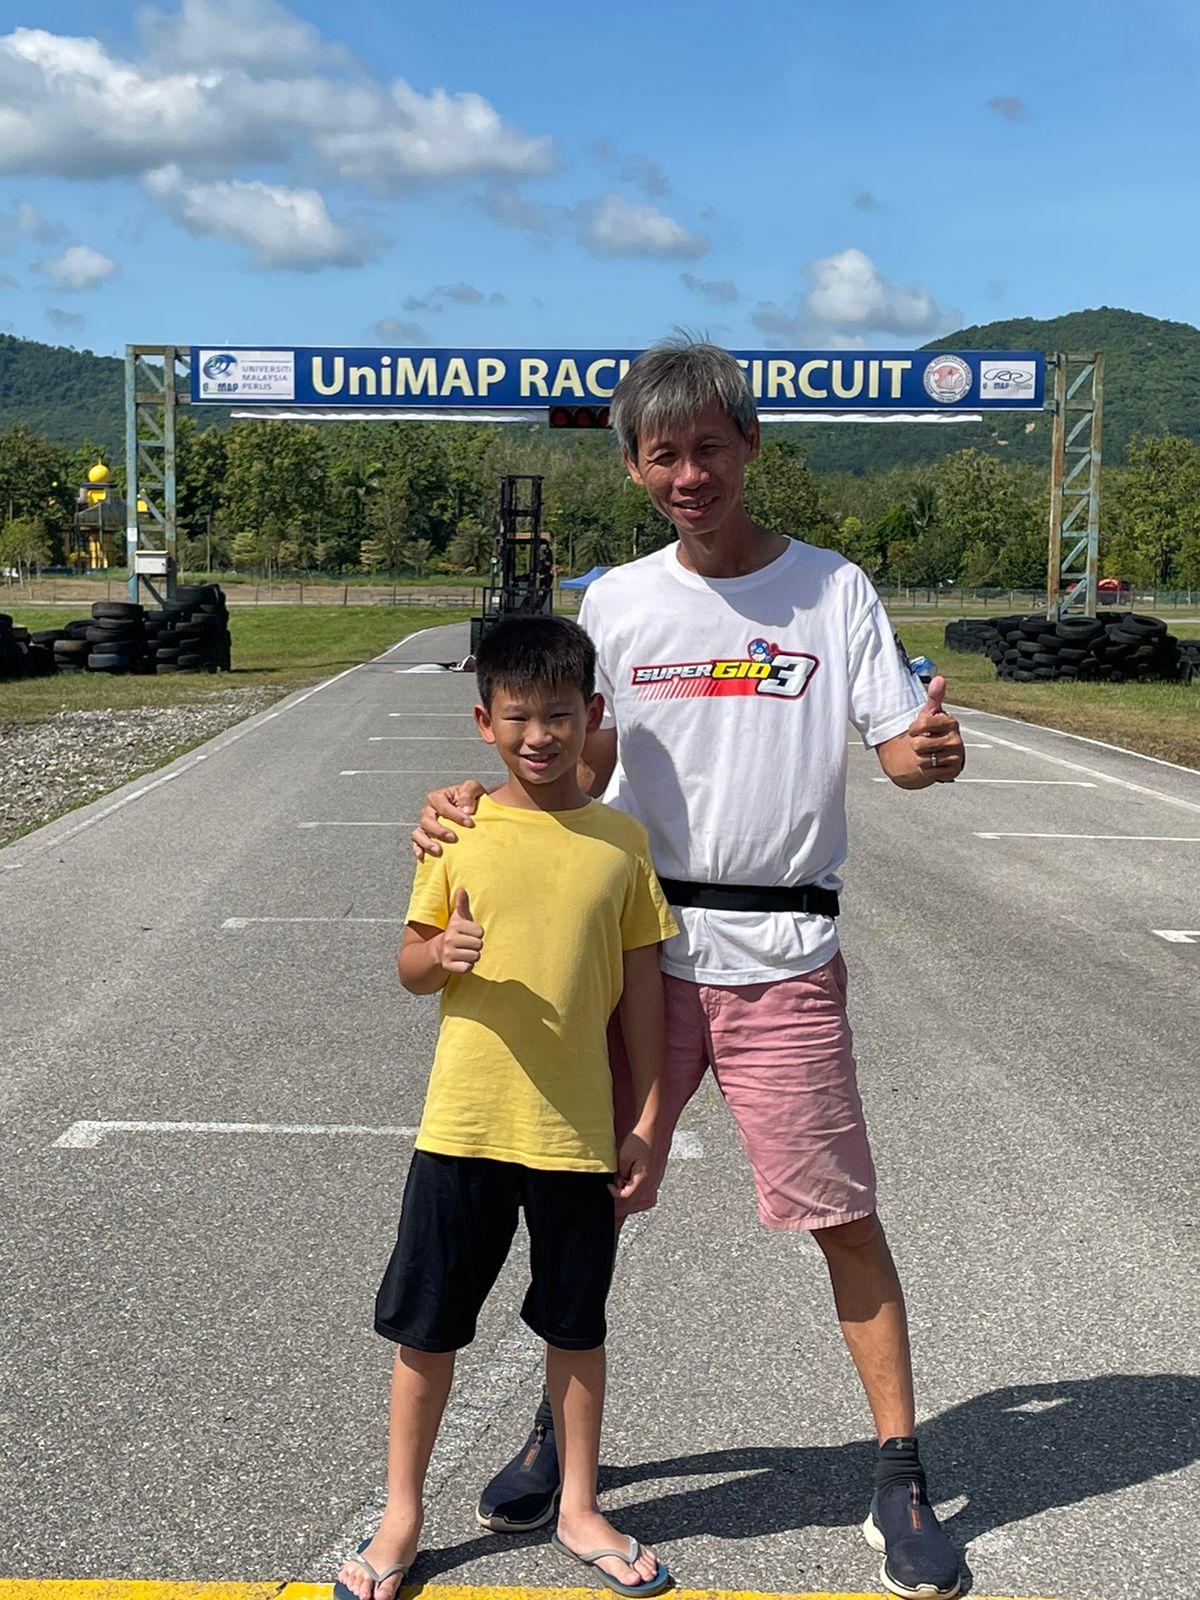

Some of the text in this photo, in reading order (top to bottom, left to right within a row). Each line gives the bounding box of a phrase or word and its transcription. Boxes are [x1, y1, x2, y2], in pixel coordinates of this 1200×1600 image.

[241, 365, 292, 373] UNIVERSITI
[241, 374, 289, 382] MALAYSIA
[312, 356, 506, 396] UniMAP
[737, 359, 912, 399] IRCUIT
[241, 382, 273, 391] PERLIS
